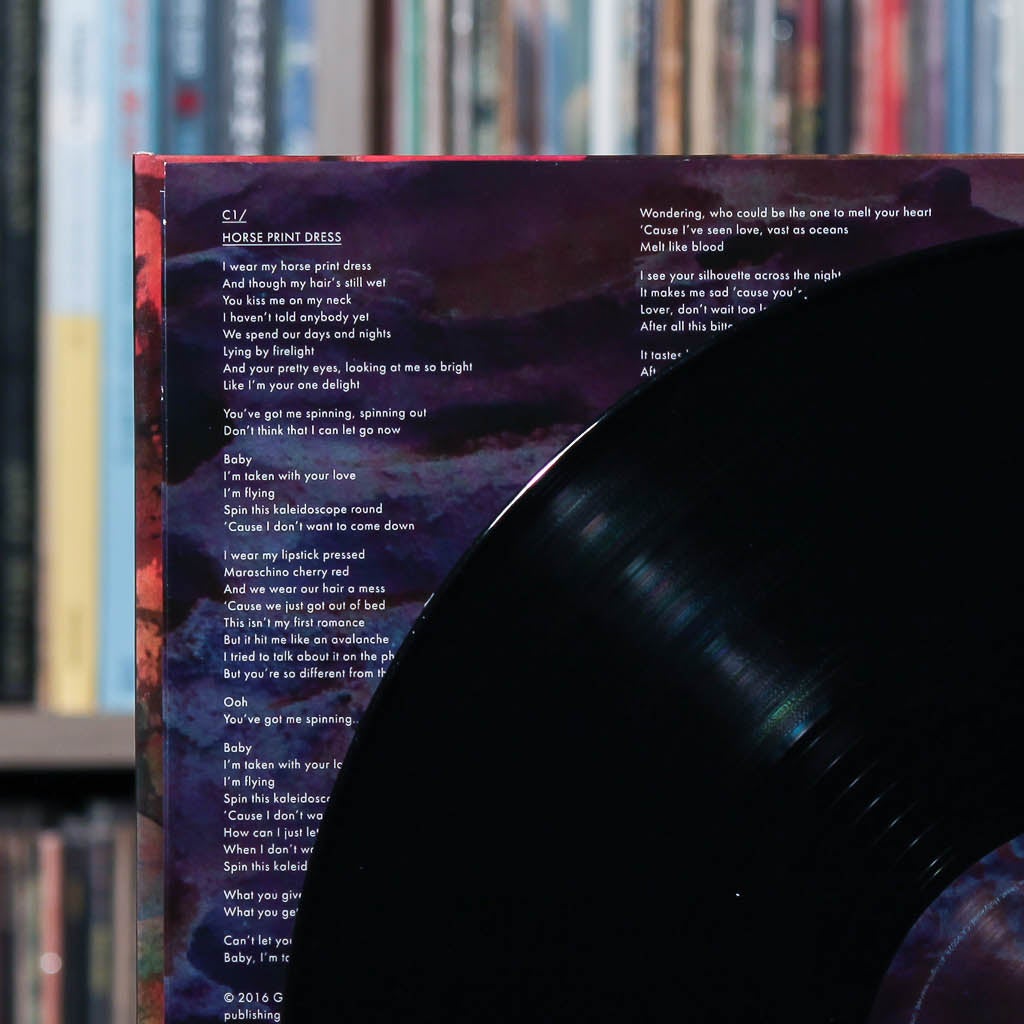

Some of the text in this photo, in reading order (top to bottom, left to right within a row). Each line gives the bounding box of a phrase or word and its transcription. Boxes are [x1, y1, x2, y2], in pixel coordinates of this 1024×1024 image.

[222, 209, 246, 220] C1/
[640, 208, 704, 220] Wondering,
[710, 207, 732, 218] who
[737, 207, 767, 218] could
[772, 207, 785, 218] be
[790, 206, 805, 218] the
[834, 209, 844, 217] to
[848, 206, 870, 217] melt
[875, 210, 900, 220] your
[904, 206, 931, 217] heart
[223, 232, 341, 242] HORSE PRINT DRESS
[640, 241, 724, 252] Melt like blood
[223, 261, 225, 271] I
[262, 264, 277, 274] my
[281, 260, 310, 271] horse
[315, 261, 339, 274] print
[343, 260, 371, 270] dress
[223, 362, 245, 373] And
[249, 366, 274, 376] your
[278, 364, 309, 375] pretty
[313, 366, 340, 375] eyes,
[346, 362, 386, 375] looking
[390, 364, 401, 372] at
[440, 361, 472, 374] bright
[224, 408, 260, 418] You've
[264, 410, 282, 421] got
[306, 408, 354, 421] spinning,
[360, 408, 405, 420] spinning
[410, 408, 426, 417] out
[224, 502, 382, 518] Spin this kaleidoscope round
[224, 566, 349, 579] Maraschino cherry red
[224, 617, 244, 628] This
[248, 617, 270, 628] isn't
[275, 620, 290, 630] my
[294, 616, 314, 627] first
[224, 696, 248, 707] Ooh
[224, 1009, 280, 1022] publishing
